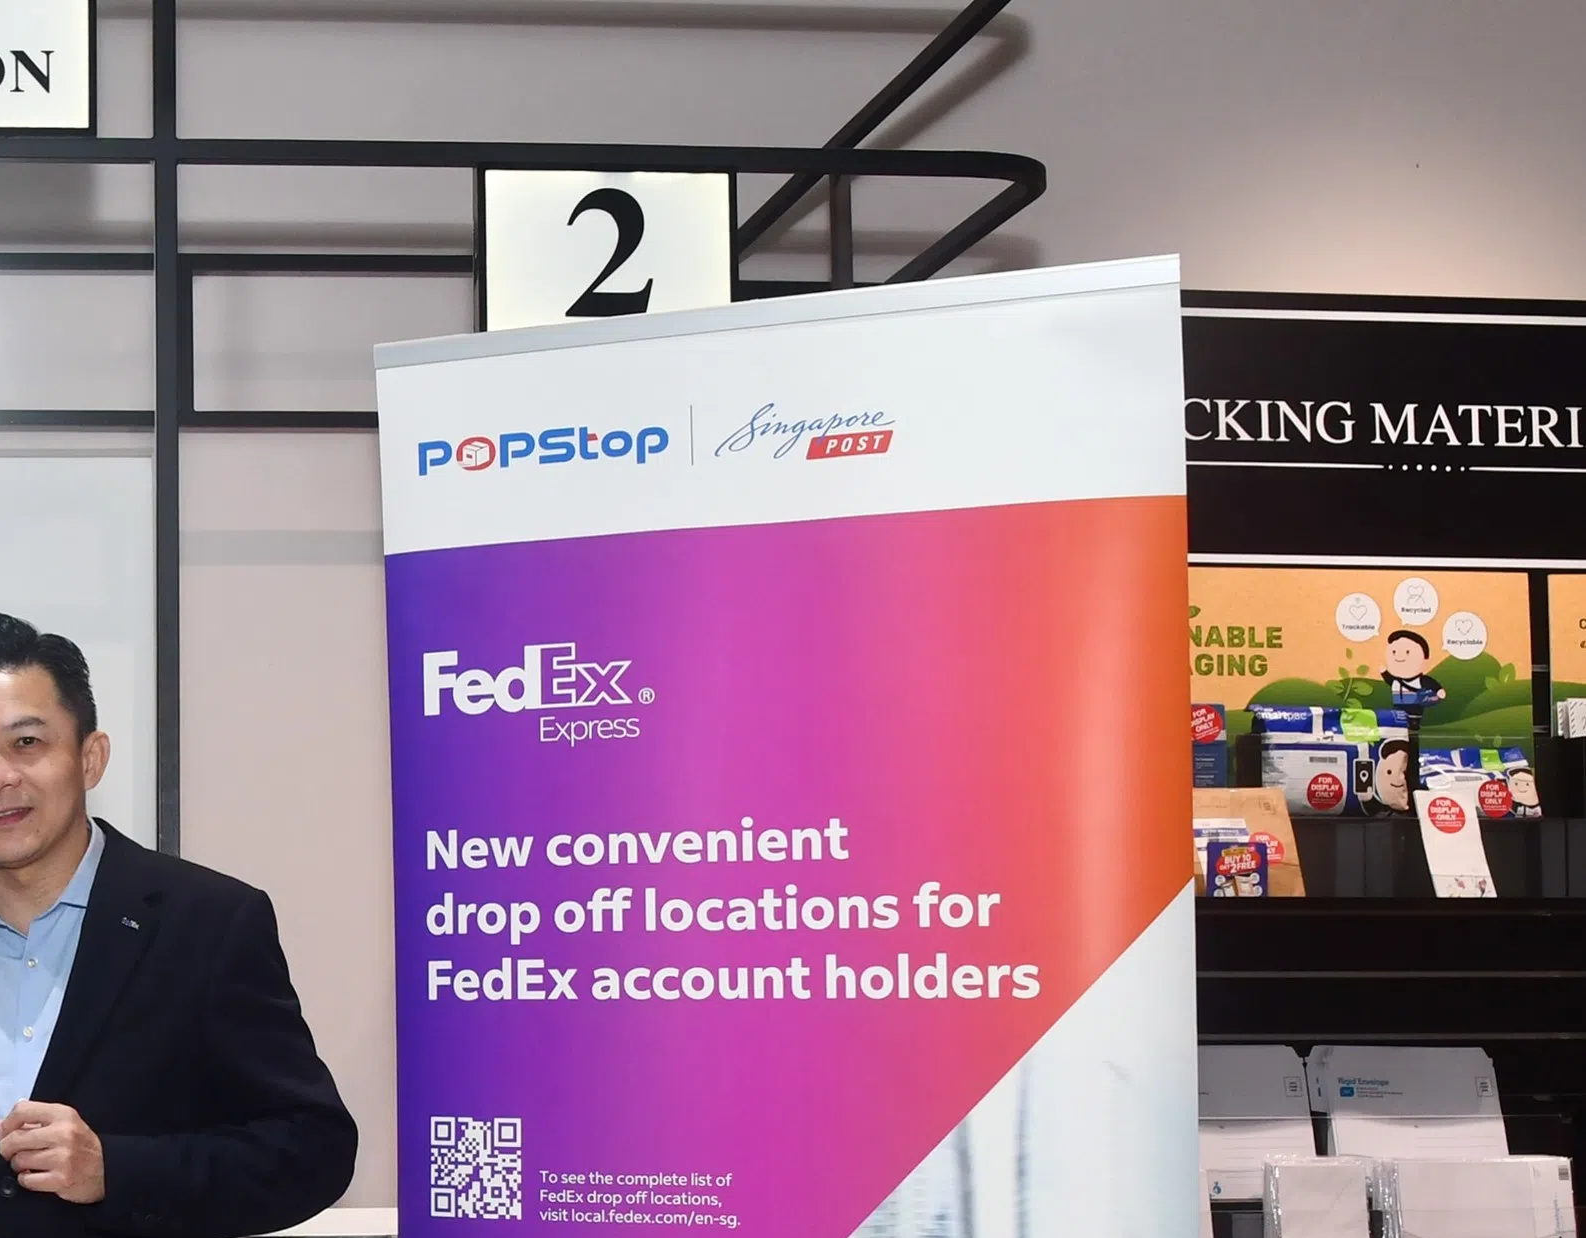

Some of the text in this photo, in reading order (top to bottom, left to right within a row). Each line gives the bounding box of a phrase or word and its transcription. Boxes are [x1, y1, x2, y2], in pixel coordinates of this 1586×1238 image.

[565, 187, 654, 318] 2
[714, 403, 895, 459] Singapore
[1184, 397, 1586, 448] CKING MATERI
[825, 434, 884, 454] POST
[1401, 606, 1431, 615] Recycled
[1342, 623, 1375, 631] Trackable
[1447, 638, 1483, 648] Recyclable
[1189, 653, 1268, 677] GING
[540, 716, 640, 747] Express
[1311, 784, 1340, 792] DISPLAY
[1318, 776, 1333, 784] FOR
[1486, 783, 1500, 791] FOR
[1480, 790, 1507, 798] DISPLAY
[1430, 806, 1460, 814] DISPLAY
[426, 816, 849, 870] New convenient
[1224, 854, 1252, 865] BUY 10
[1237, 861, 1256, 870] FREE
[426, 881, 1001, 945] drop off locations for
[428, 953, 1041, 1001] FedEx account holders
[539, 1170, 733, 1189] To see the complete list of
[539, 1189, 722, 1208] FedEx drop off locations,
[539, 1207, 742, 1229] visit local.fedex.com/en-sg.
